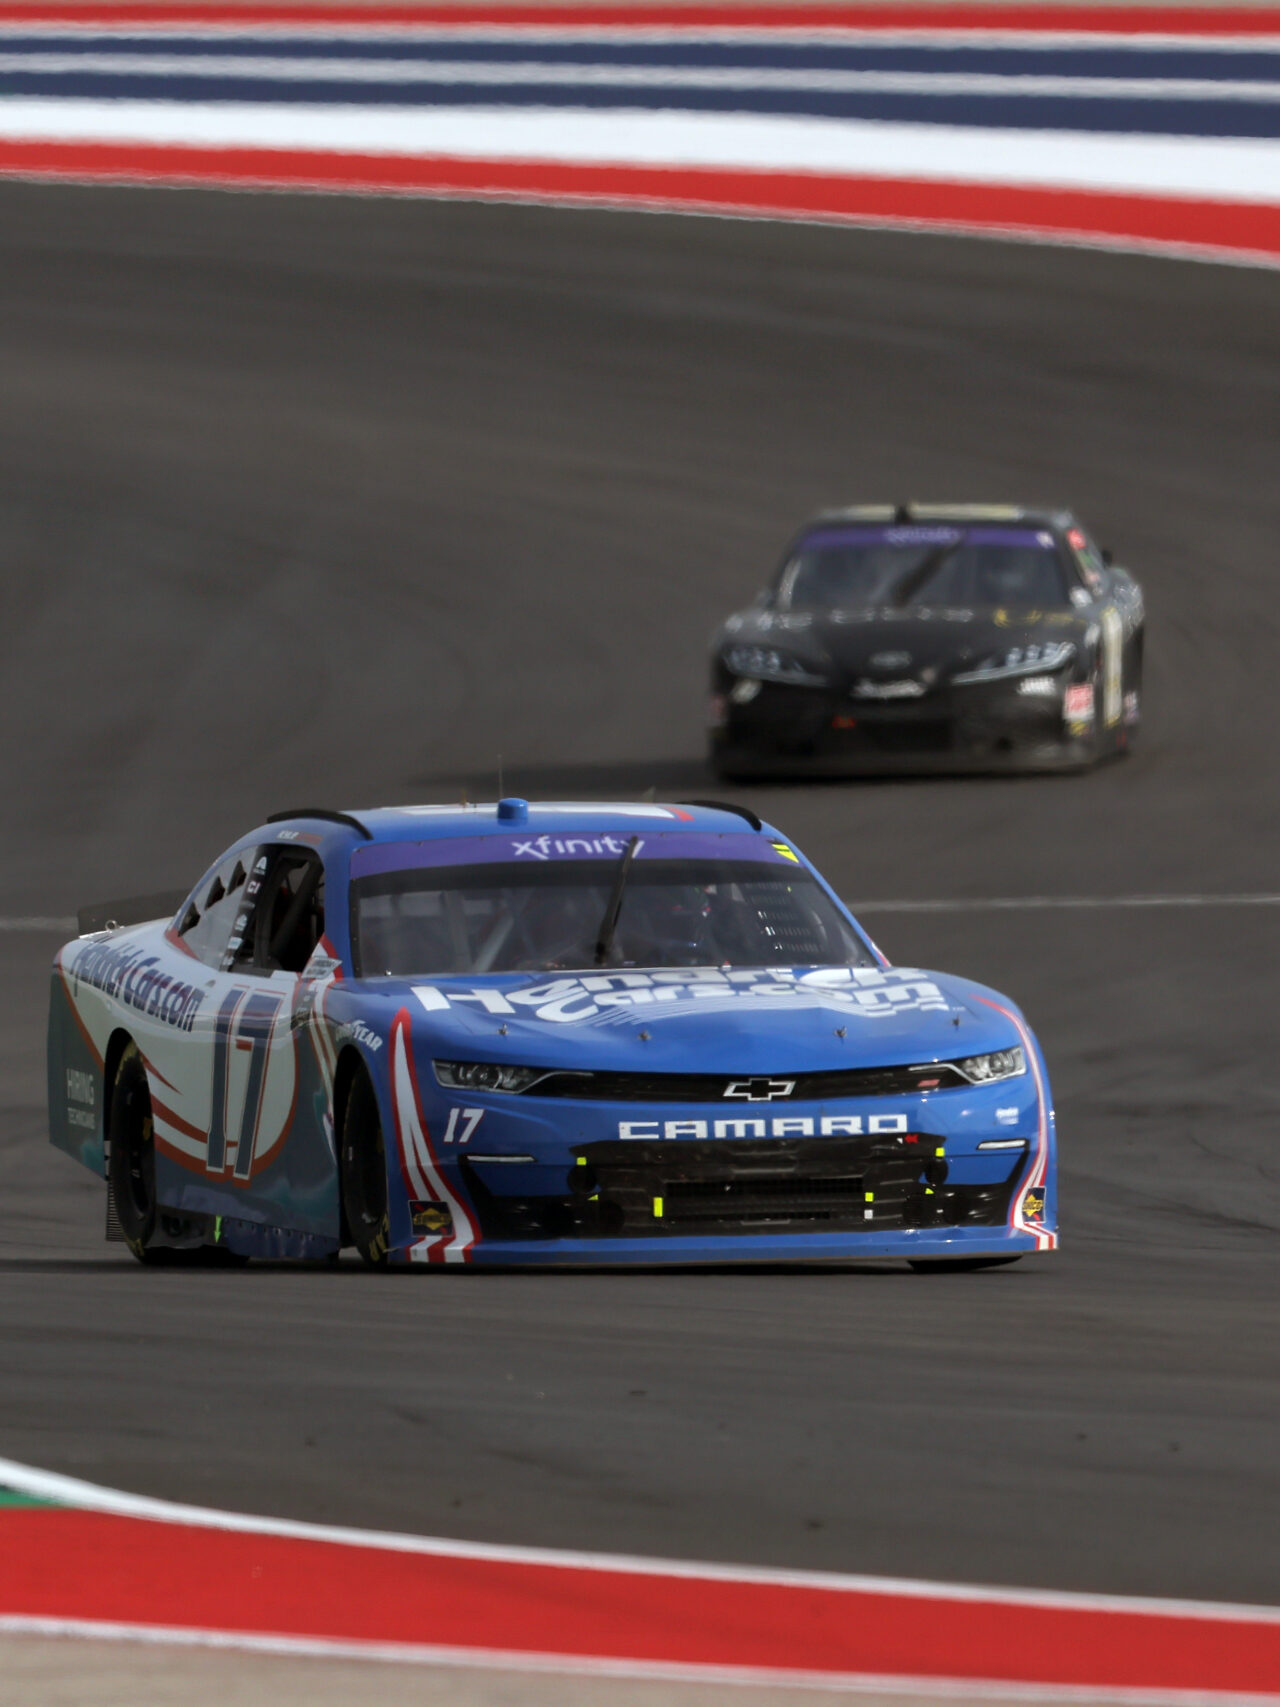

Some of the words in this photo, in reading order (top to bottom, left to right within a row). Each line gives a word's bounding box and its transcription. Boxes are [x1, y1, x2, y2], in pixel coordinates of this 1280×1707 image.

[511, 835, 646, 860] xfinity
[206, 983, 287, 1188] 17
[442, 1107, 485, 1144] 17
[618, 1113, 908, 1139] CAMARO
